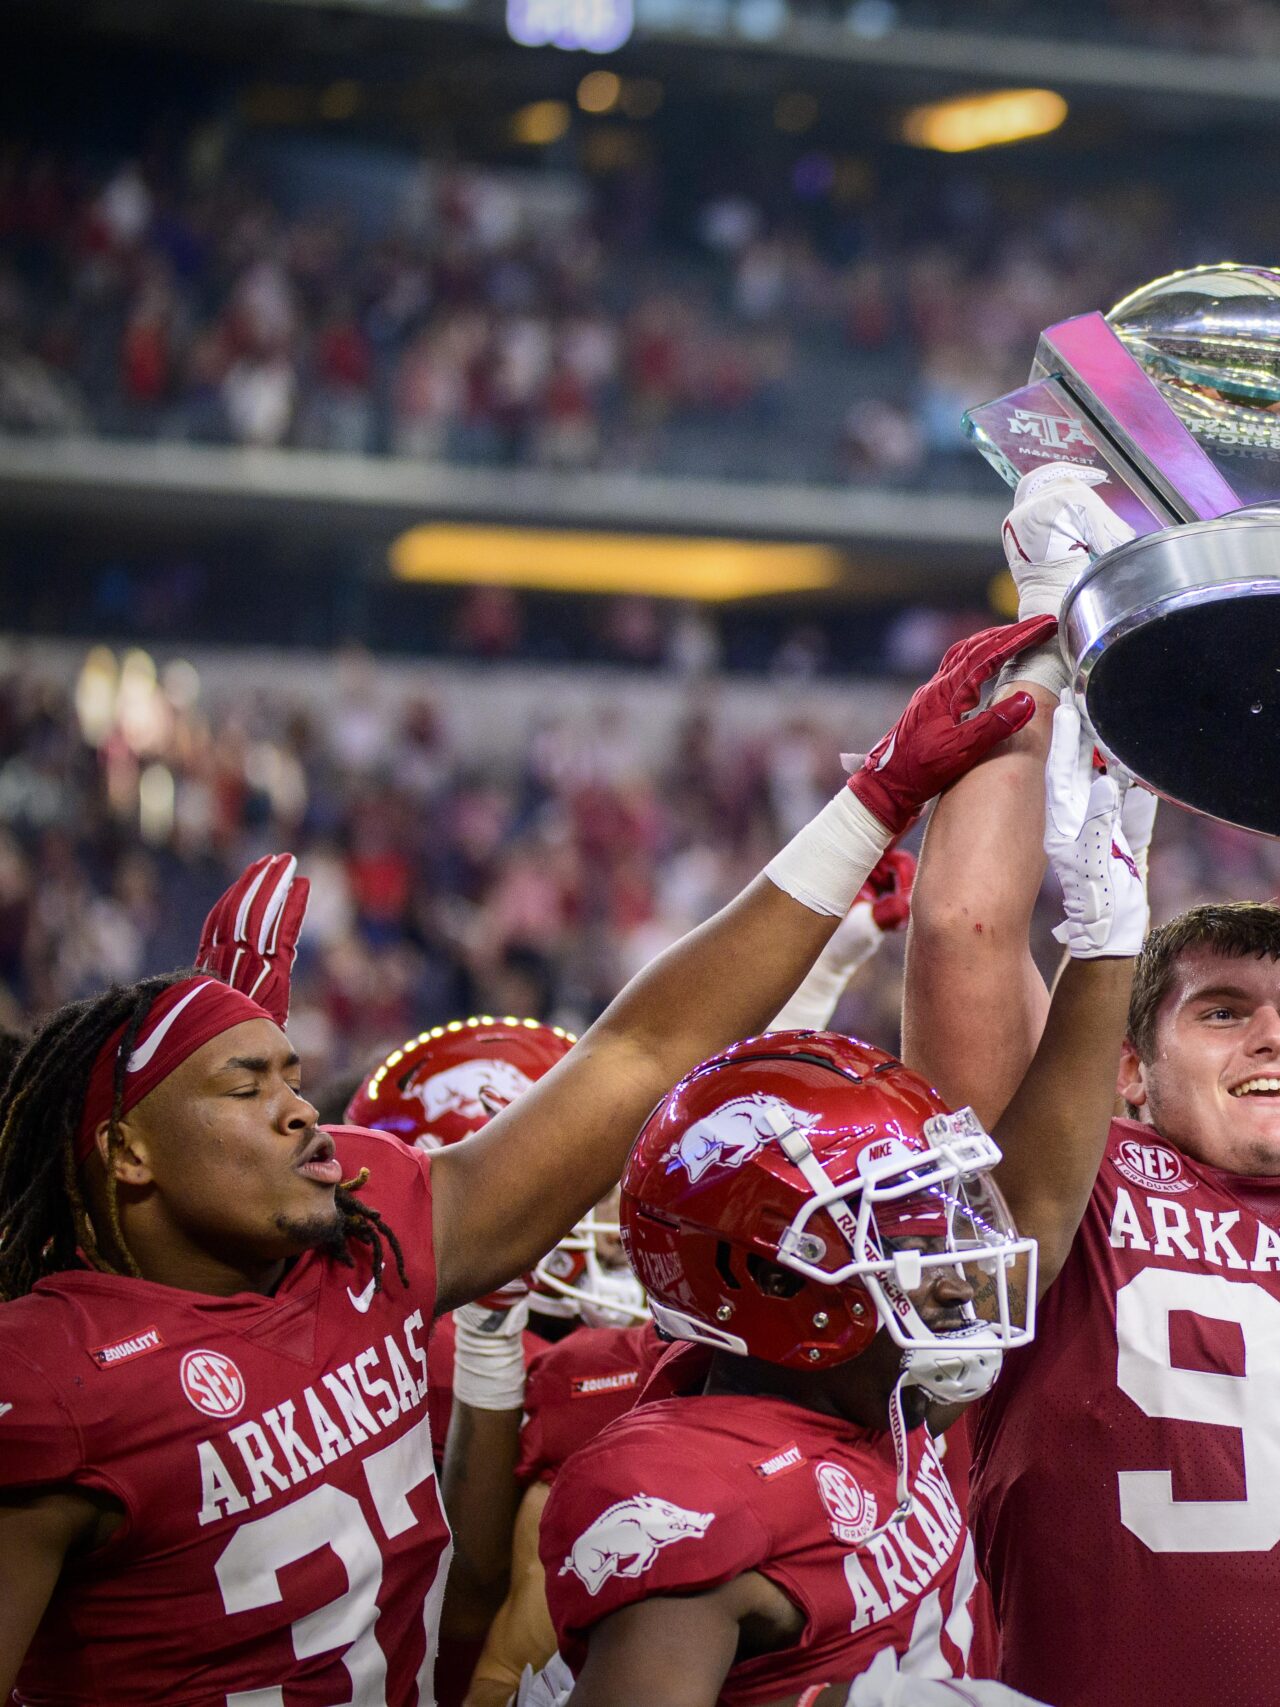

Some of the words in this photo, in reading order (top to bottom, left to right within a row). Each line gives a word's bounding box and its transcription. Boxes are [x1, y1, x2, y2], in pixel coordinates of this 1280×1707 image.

[868, 1141, 893, 1163] NIKE
[1125, 1142, 1175, 1180] SEC
[1123, 1168, 1182, 1192] GRADUATE
[103, 1330, 160, 1362] EQUALITY
[186, 1354, 240, 1412] SEC
[580, 1372, 639, 1393] EQUALITY
[198, 1309, 429, 1526] ARKANSAS
[760, 1446, 802, 1476] EQUALITY
[819, 1466, 861, 1524] SEC
[214, 1411, 454, 1707] 37
